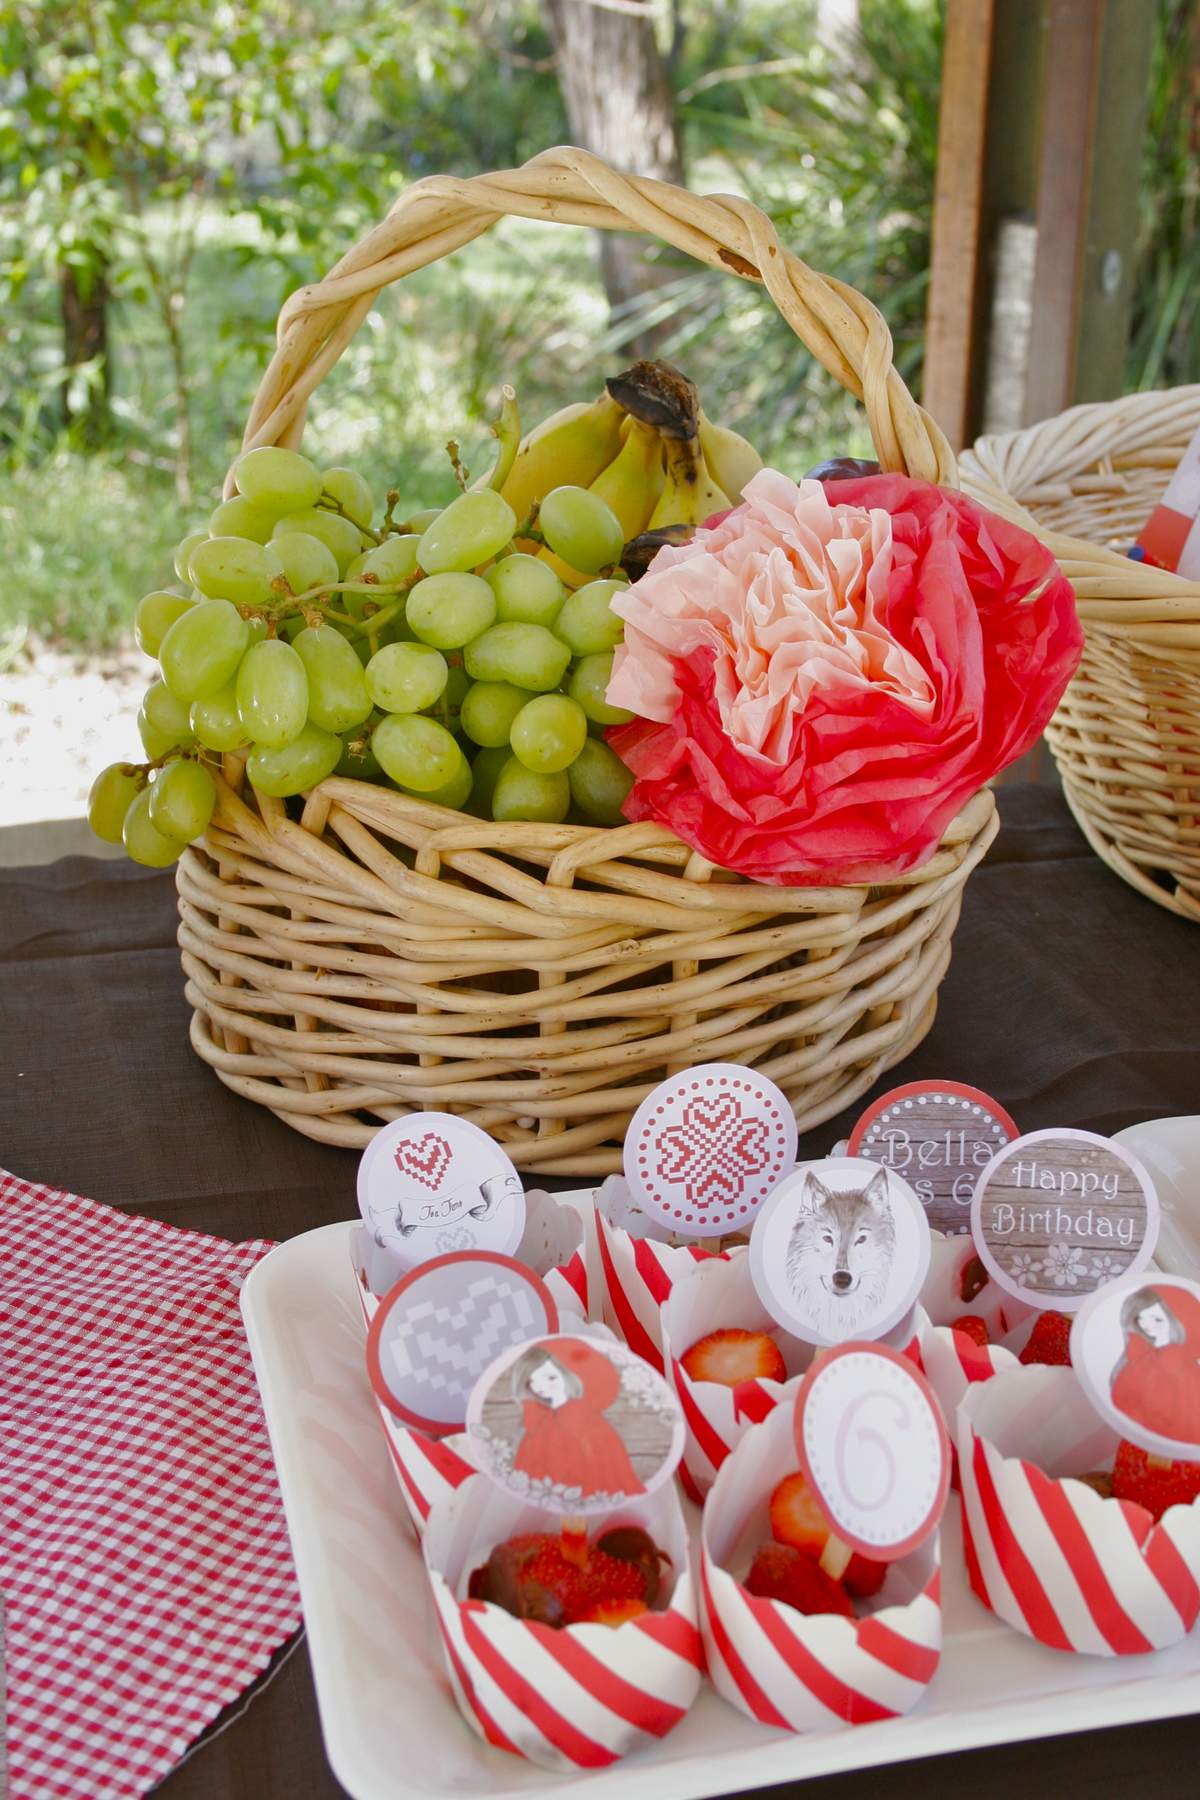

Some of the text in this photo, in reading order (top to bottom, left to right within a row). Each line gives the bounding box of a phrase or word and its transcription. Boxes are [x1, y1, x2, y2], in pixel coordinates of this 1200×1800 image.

[881, 1128, 993, 1169] Bella
[952, 1173, 976, 1205] 6
[1012, 1161, 1120, 1199] Happy
[992, 1204, 1135, 1245] Birthday
[834, 1389, 911, 1512] 6
